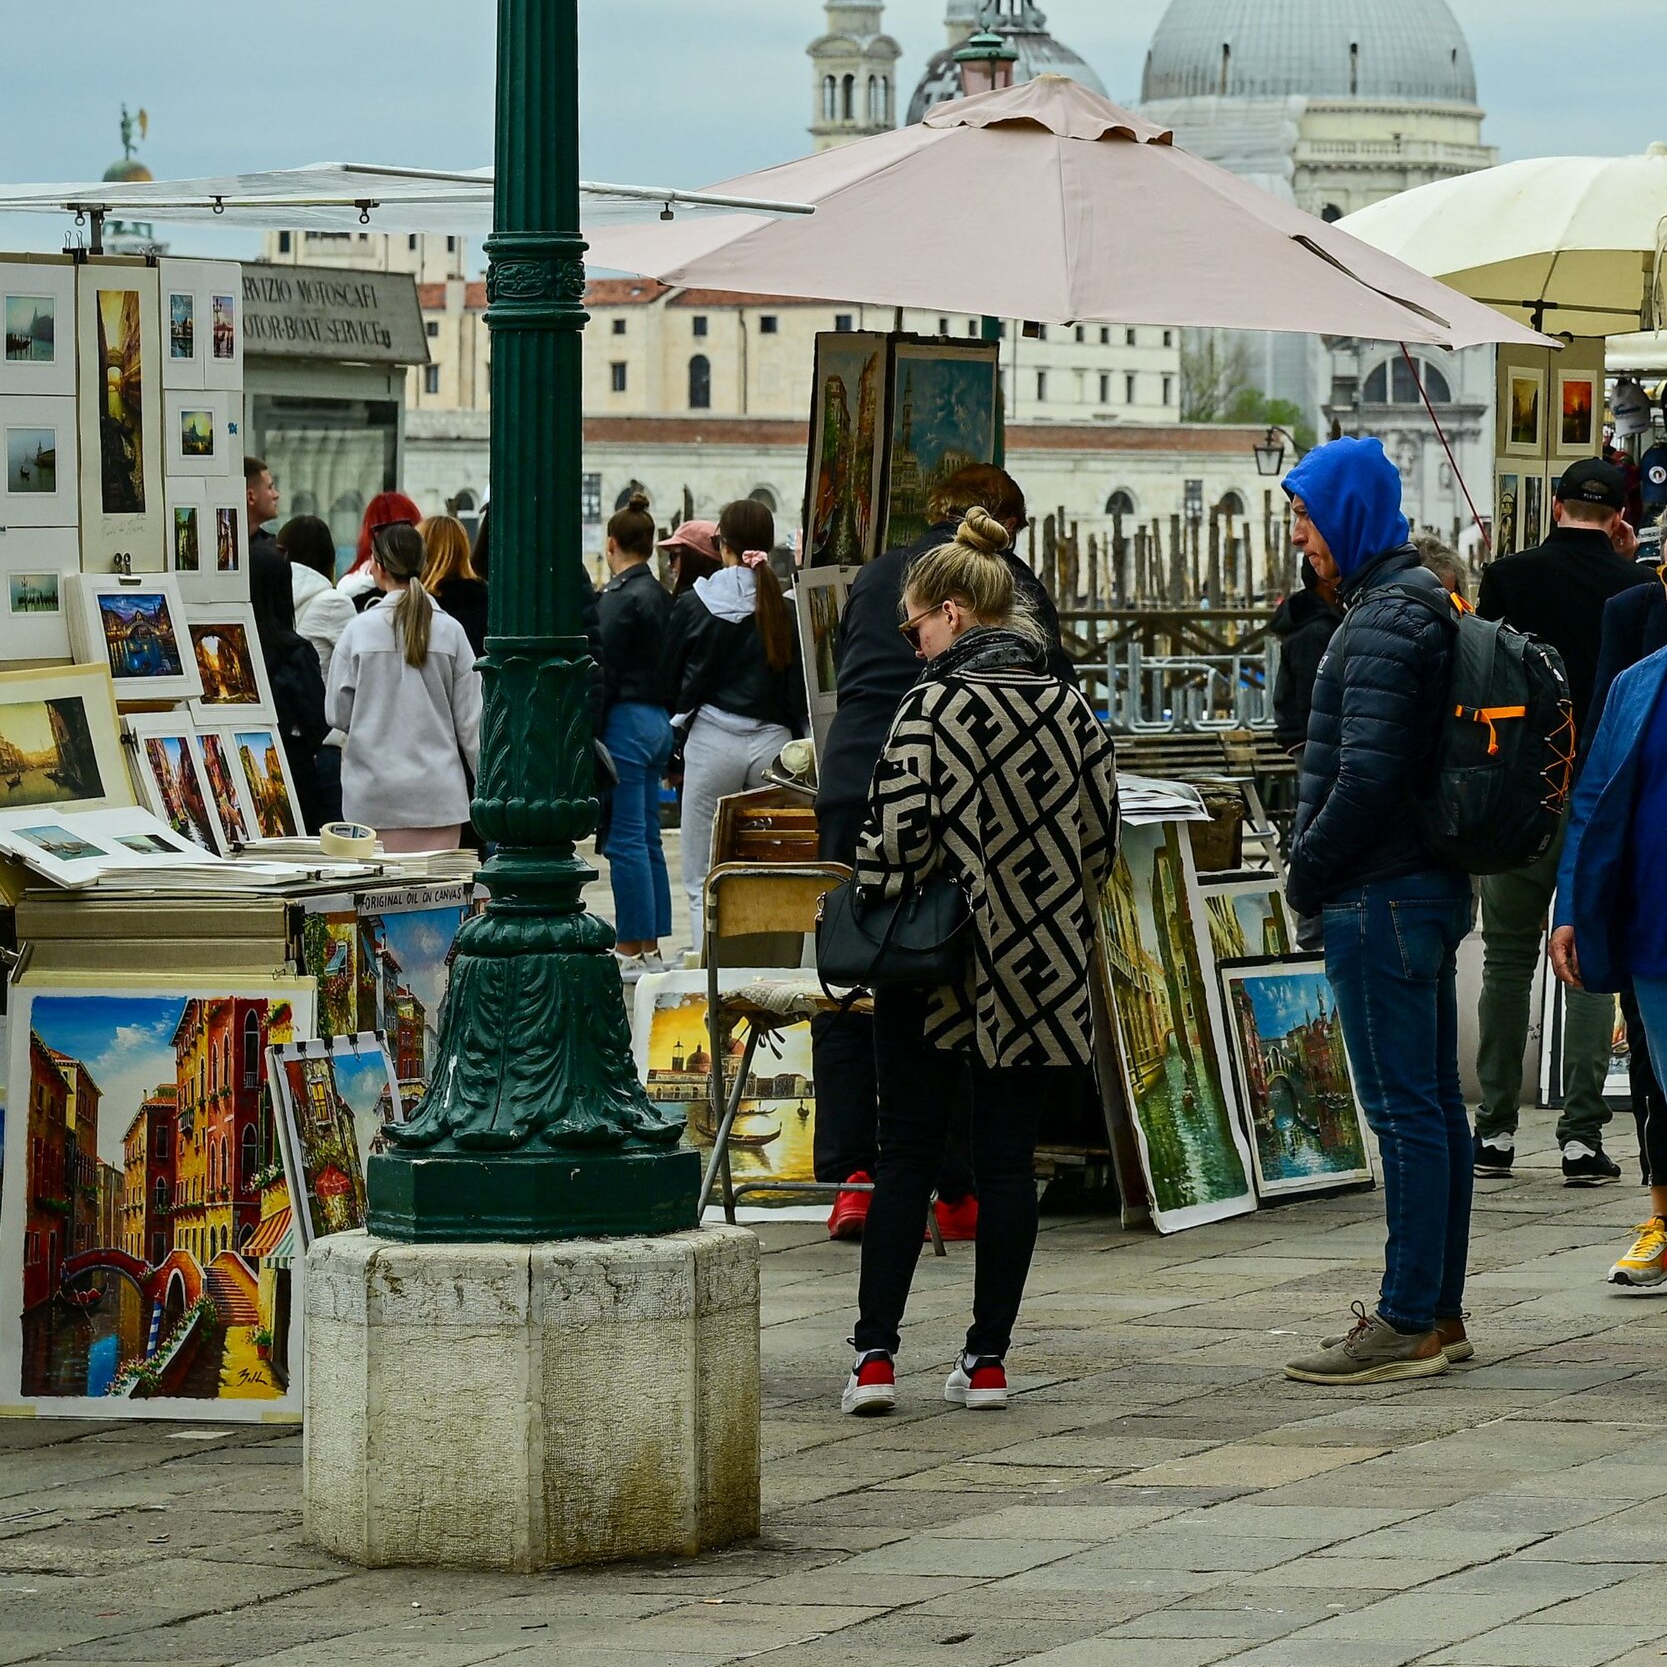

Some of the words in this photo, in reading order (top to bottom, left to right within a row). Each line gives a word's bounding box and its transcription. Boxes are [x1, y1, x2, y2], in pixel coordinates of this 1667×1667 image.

[242, 277, 292, 303] RVIZIO
[297, 279, 378, 309] MOTOSCAFI
[327, 319, 382, 346] SERVICE
[365, 895, 402, 910] ORIGINAL
[407, 893, 418, 904] OIL
[422, 892, 432, 903] ON
[434, 887, 462, 902] CANVAS
